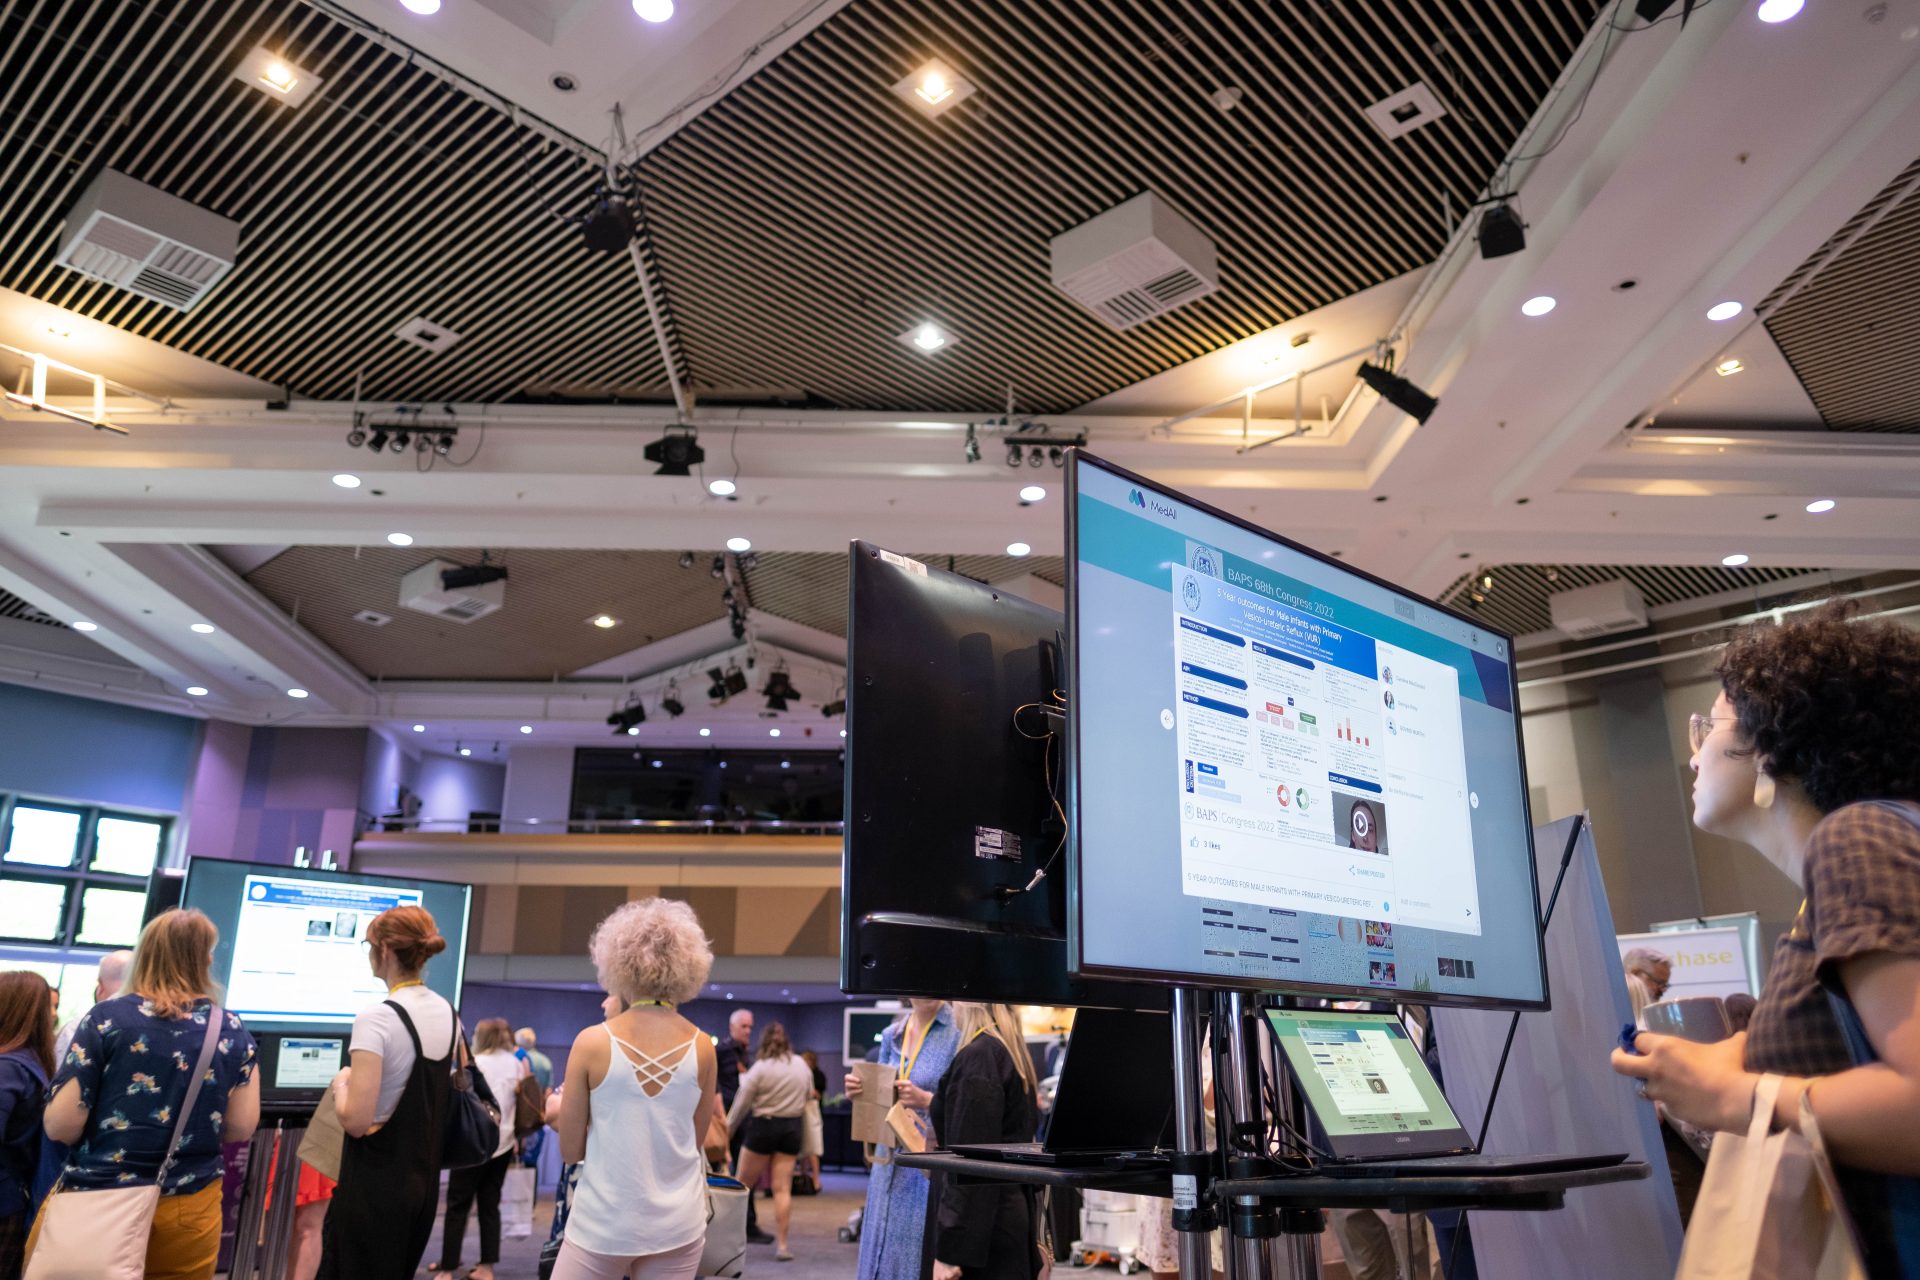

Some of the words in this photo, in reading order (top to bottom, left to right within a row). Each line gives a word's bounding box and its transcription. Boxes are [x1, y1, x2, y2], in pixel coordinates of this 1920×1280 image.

[1228, 568, 1253, 587] BAPS
[1254, 579, 1273, 596] 68th
[1275, 587, 1313, 611] Congress
[1314, 602, 1335, 619] 2022
[1237, 597, 1266, 613] outcomes
[1266, 606, 1275, 616] for
[1276, 609, 1290, 622] Male
[1309, 623, 1322, 634] with
[1322, 627, 1342, 643] Primary
[1196, 807, 1218, 822] BAPS
[1221, 812, 1257, 829] Congress
[1257, 819, 1275, 833] 2022
[1203, 840, 1208, 848] 3
[1208, 841, 1221, 851] likes
[1192, 873, 1207, 882] YEAR
[1208, 876, 1239, 888] OUTCOMES
[1239, 880, 1250, 889] FOR
[1250, 882, 1265, 892] MALE
[1265, 885, 1287, 895] INFANTS
[1288, 888, 1301, 897] WITH
[1667, 949, 1733, 968] hase
